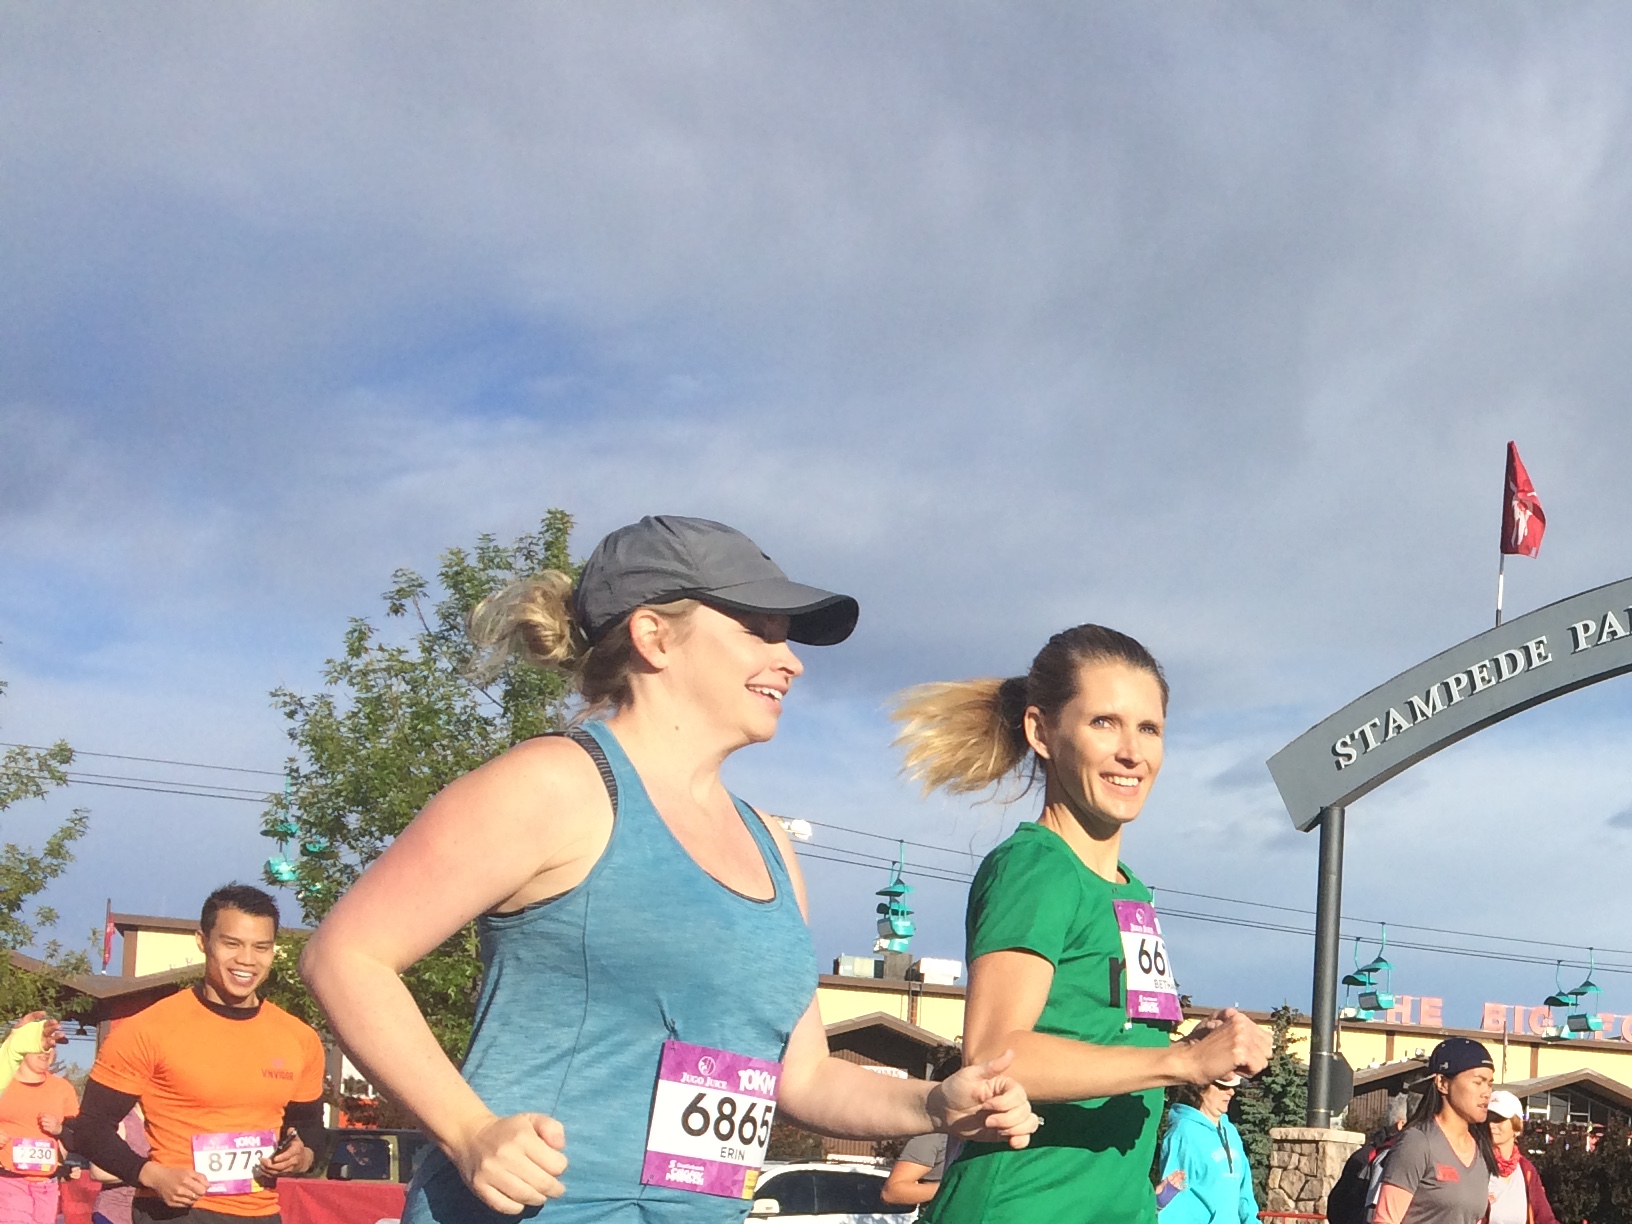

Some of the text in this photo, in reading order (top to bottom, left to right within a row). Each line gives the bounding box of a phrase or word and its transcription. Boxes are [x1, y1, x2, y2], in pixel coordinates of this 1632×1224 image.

[1334, 635, 1553, 770] STAMPEDE
[1386, 995, 1443, 1027] HE
[1482, 1003, 1554, 1036] BIG
[738, 1069, 776, 1096] 10KM
[681, 1093, 773, 1148] 6865
[720, 1147, 746, 1160] ERIN
